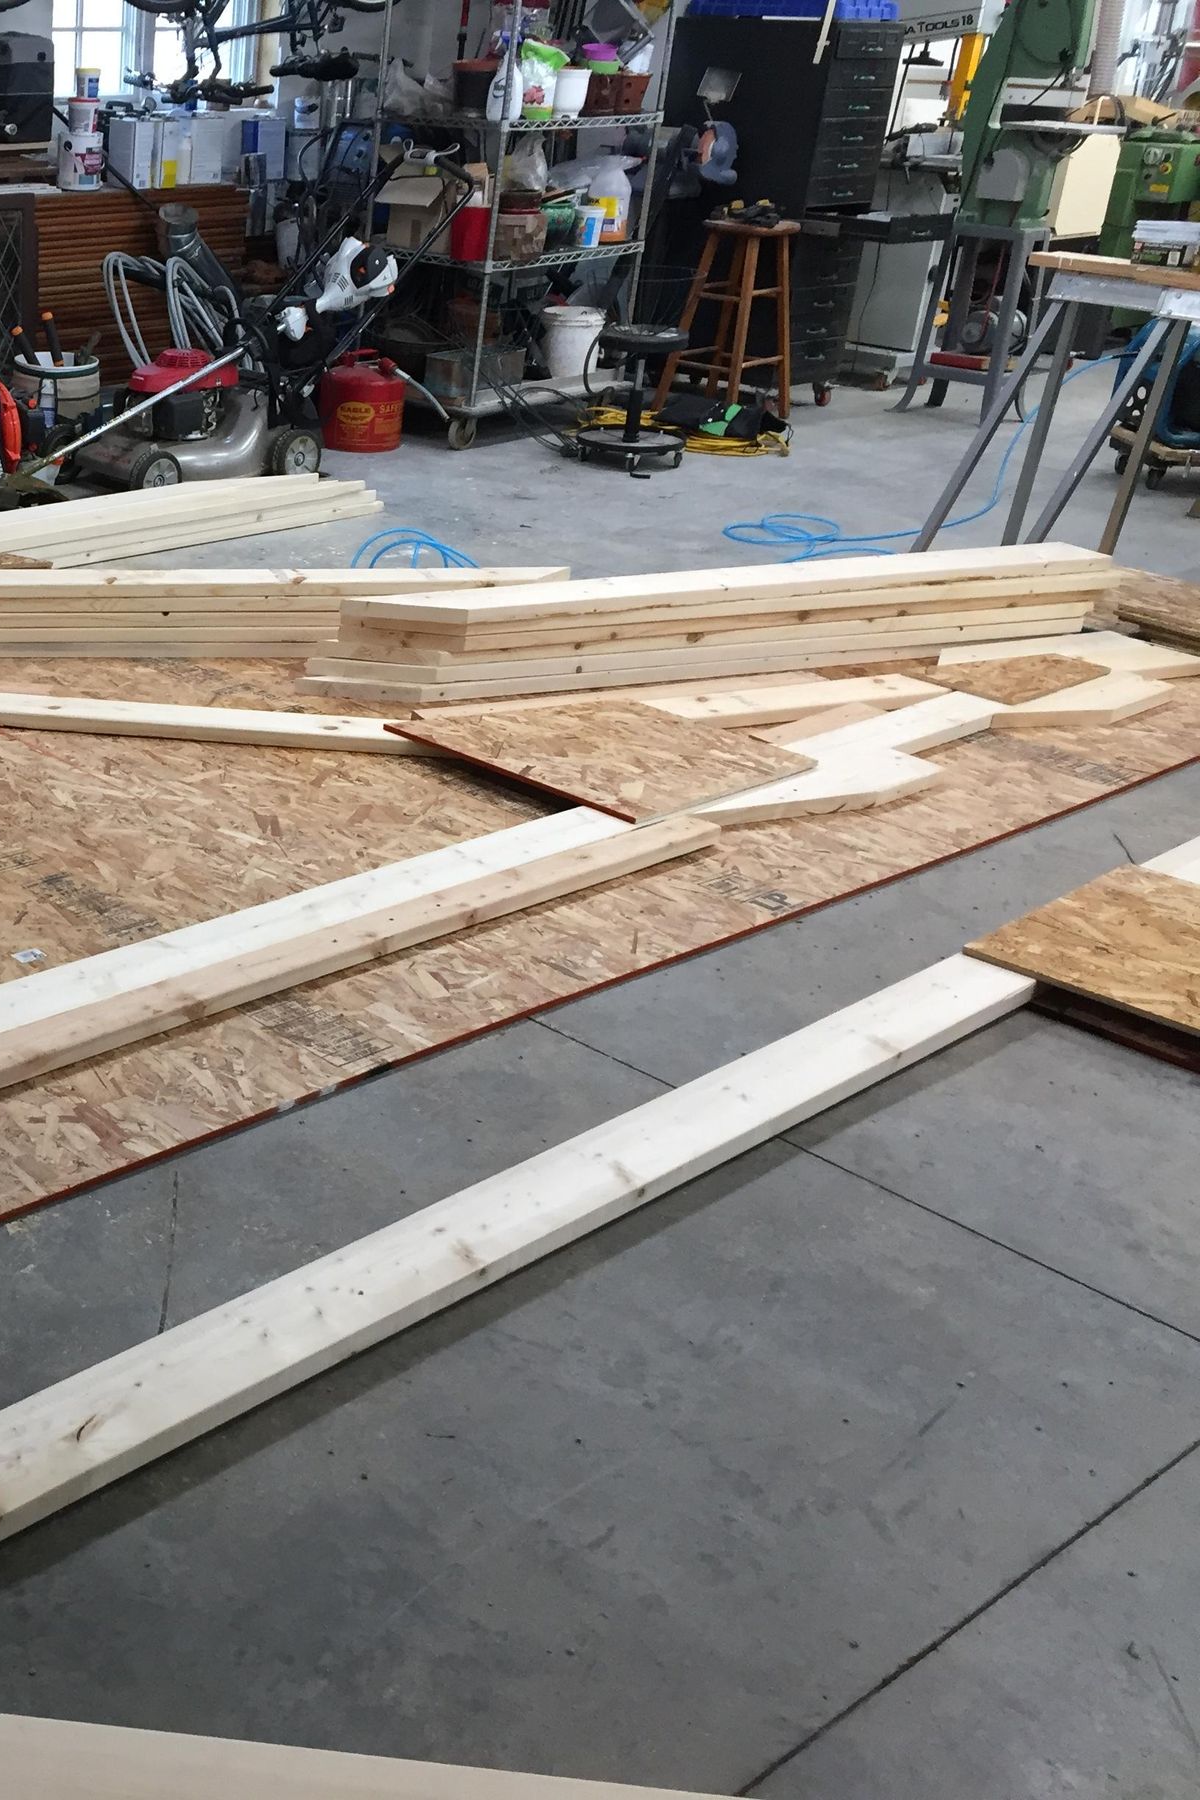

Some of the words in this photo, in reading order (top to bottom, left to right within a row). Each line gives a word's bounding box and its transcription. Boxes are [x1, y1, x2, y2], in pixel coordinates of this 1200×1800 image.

[917, 18, 960, 33] TOOLS
[961, 14, 974, 26] 18
[747, 892, 793, 912] LP
